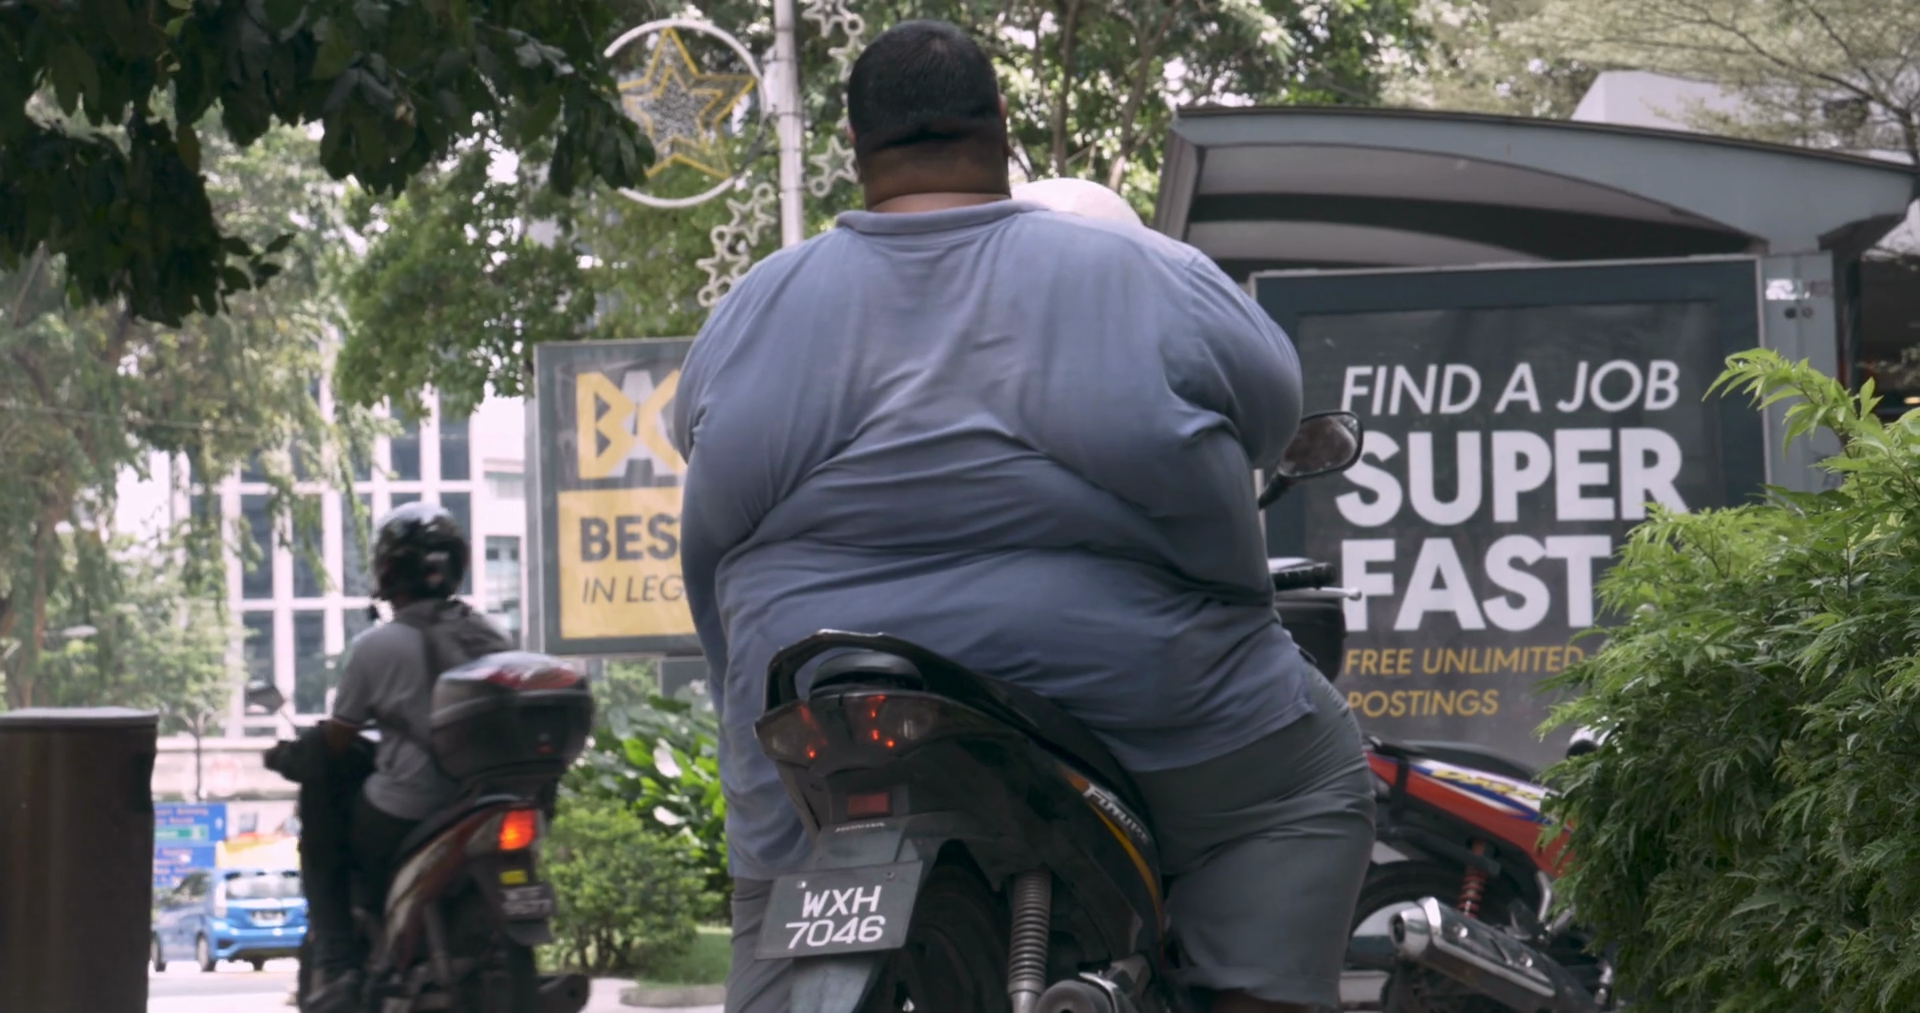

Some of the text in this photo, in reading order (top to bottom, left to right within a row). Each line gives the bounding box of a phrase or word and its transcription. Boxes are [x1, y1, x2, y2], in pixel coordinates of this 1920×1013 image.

[1341, 359, 1681, 416] FIND A JOB
[1335, 428, 1691, 527] SUPER
[580, 513, 681, 562] BES
[582, 574, 688, 604] IN LEG
[1341, 534, 1612, 632] FAST
[1344, 646, 1585, 676] FREE UNLIMITED
[1348, 689, 1499, 718] POSTINGS
[802, 885, 882, 919] WXH
[785, 915, 886, 949] 7046
